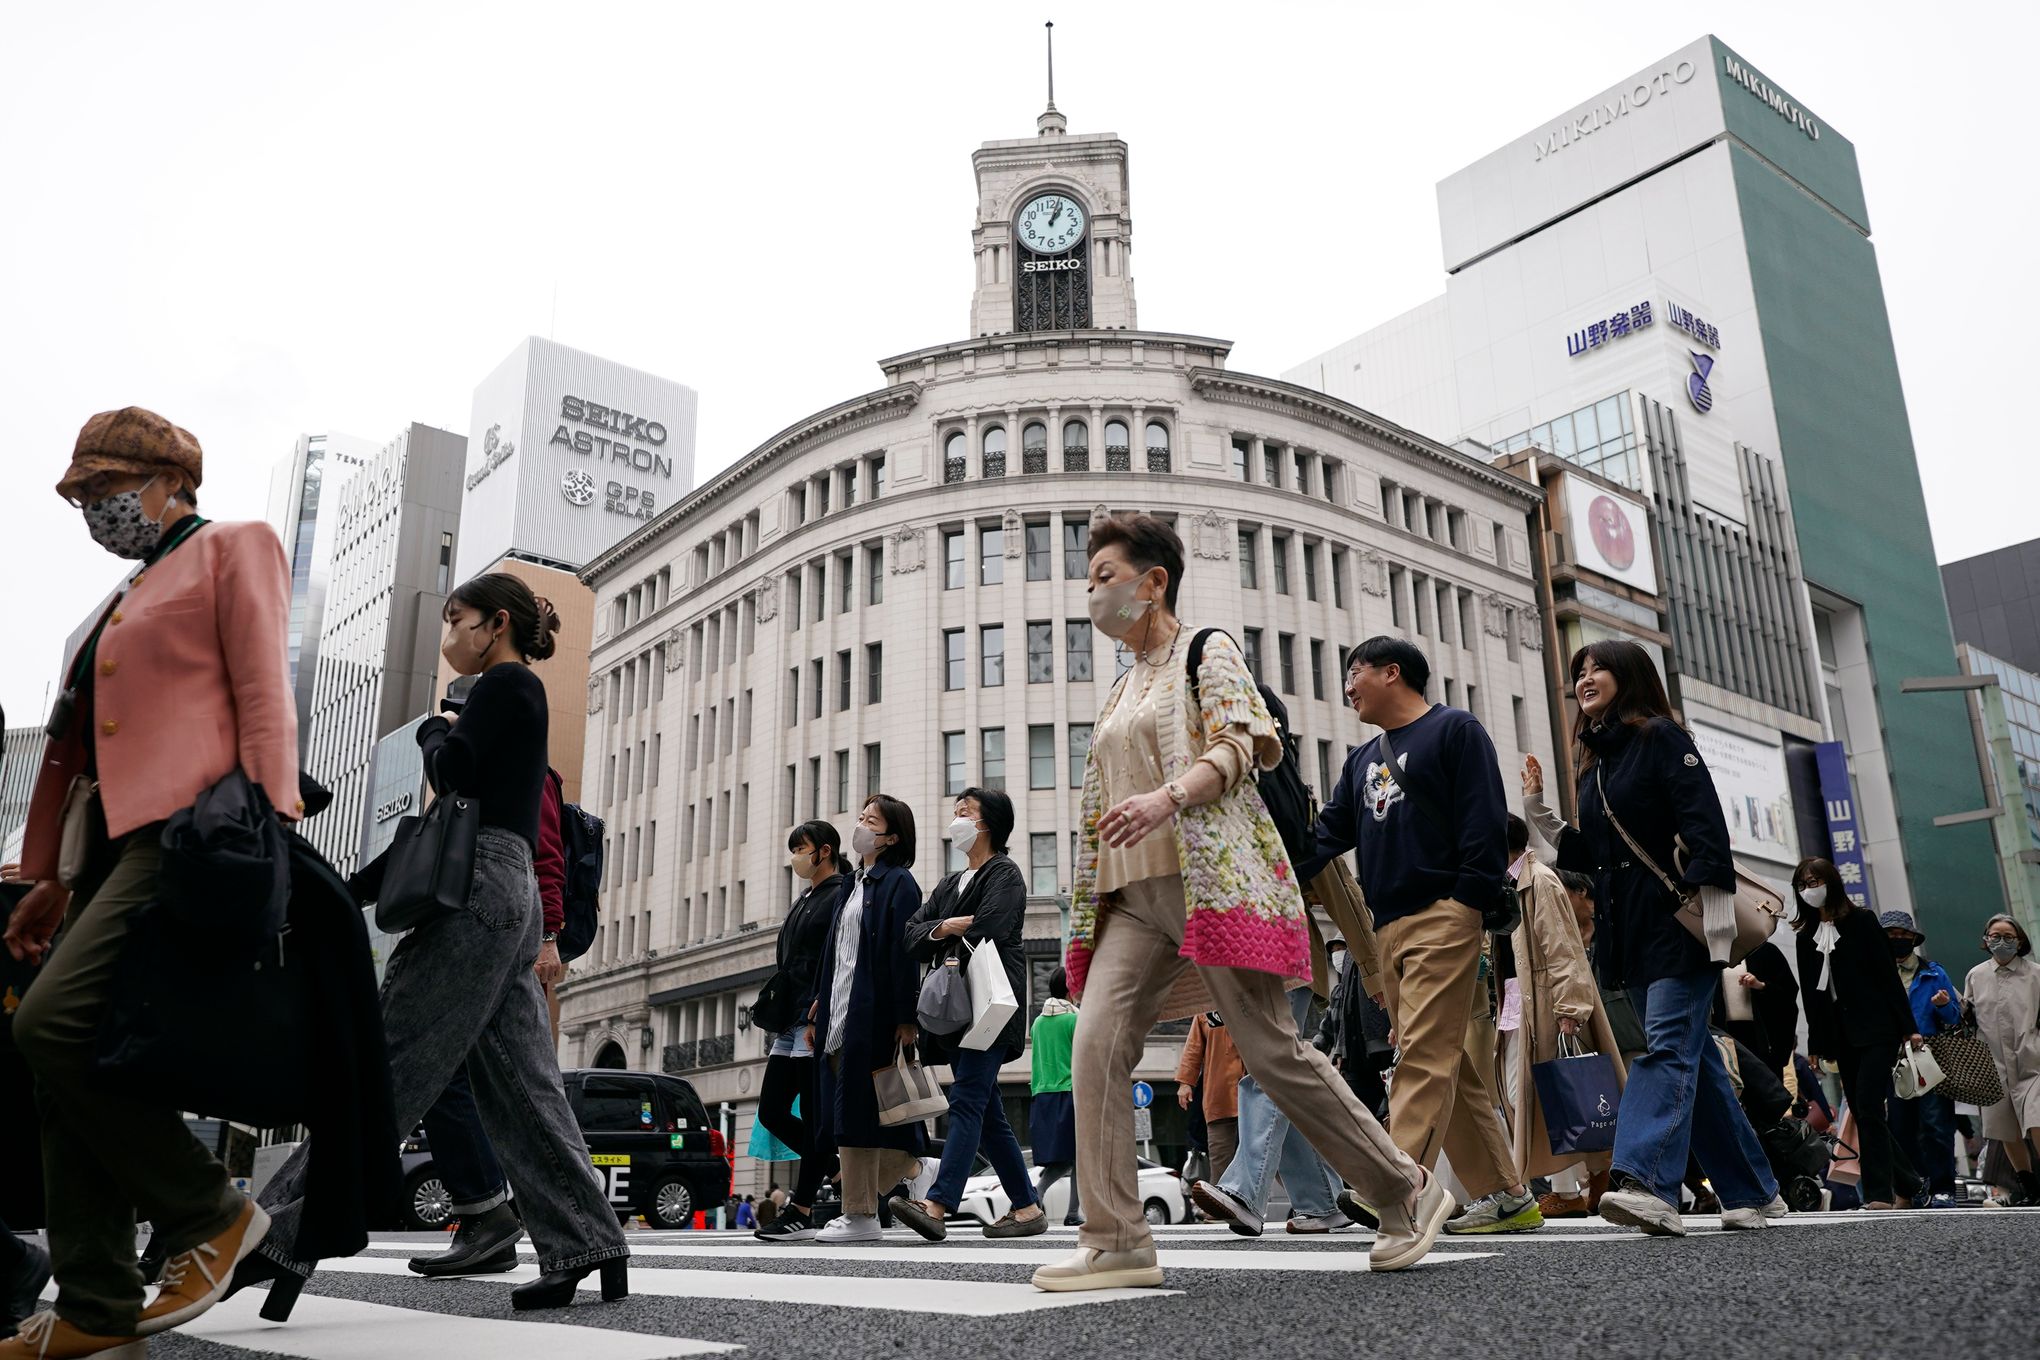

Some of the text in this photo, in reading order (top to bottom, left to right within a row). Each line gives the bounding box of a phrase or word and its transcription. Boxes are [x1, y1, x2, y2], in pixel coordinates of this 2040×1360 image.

[1723, 55, 1821, 141] MIKIMOTO
[1534, 60, 1696, 163] MIKIMOTO
[1036, 202, 1044, 212] 11
[1046, 200, 1056, 209] 12
[1027, 210, 1036, 220] 10
[1066, 208, 1074, 217] 2
[1024, 220, 1032, 230] 9
[1070, 217, 1078, 227] 3
[1028, 230, 1037, 240] 8
[1066, 228, 1075, 237] 4
[1038, 236, 1045, 246] 7
[1047, 239, 1055, 248] 6
[1058, 235, 1066, 245] 5
[1023, 258, 1080, 272] SEIKO
[1566, 300, 1654, 357] 山野楽器
[1667, 299, 1721, 350] 山野楽器
[561, 394, 668, 446] SEIKO
[549, 425, 672, 479] ASTRON
[605, 481, 655, 508] GPS
[604, 497, 655, 521] SOLAR
[375, 791, 412, 824] SEIKO
